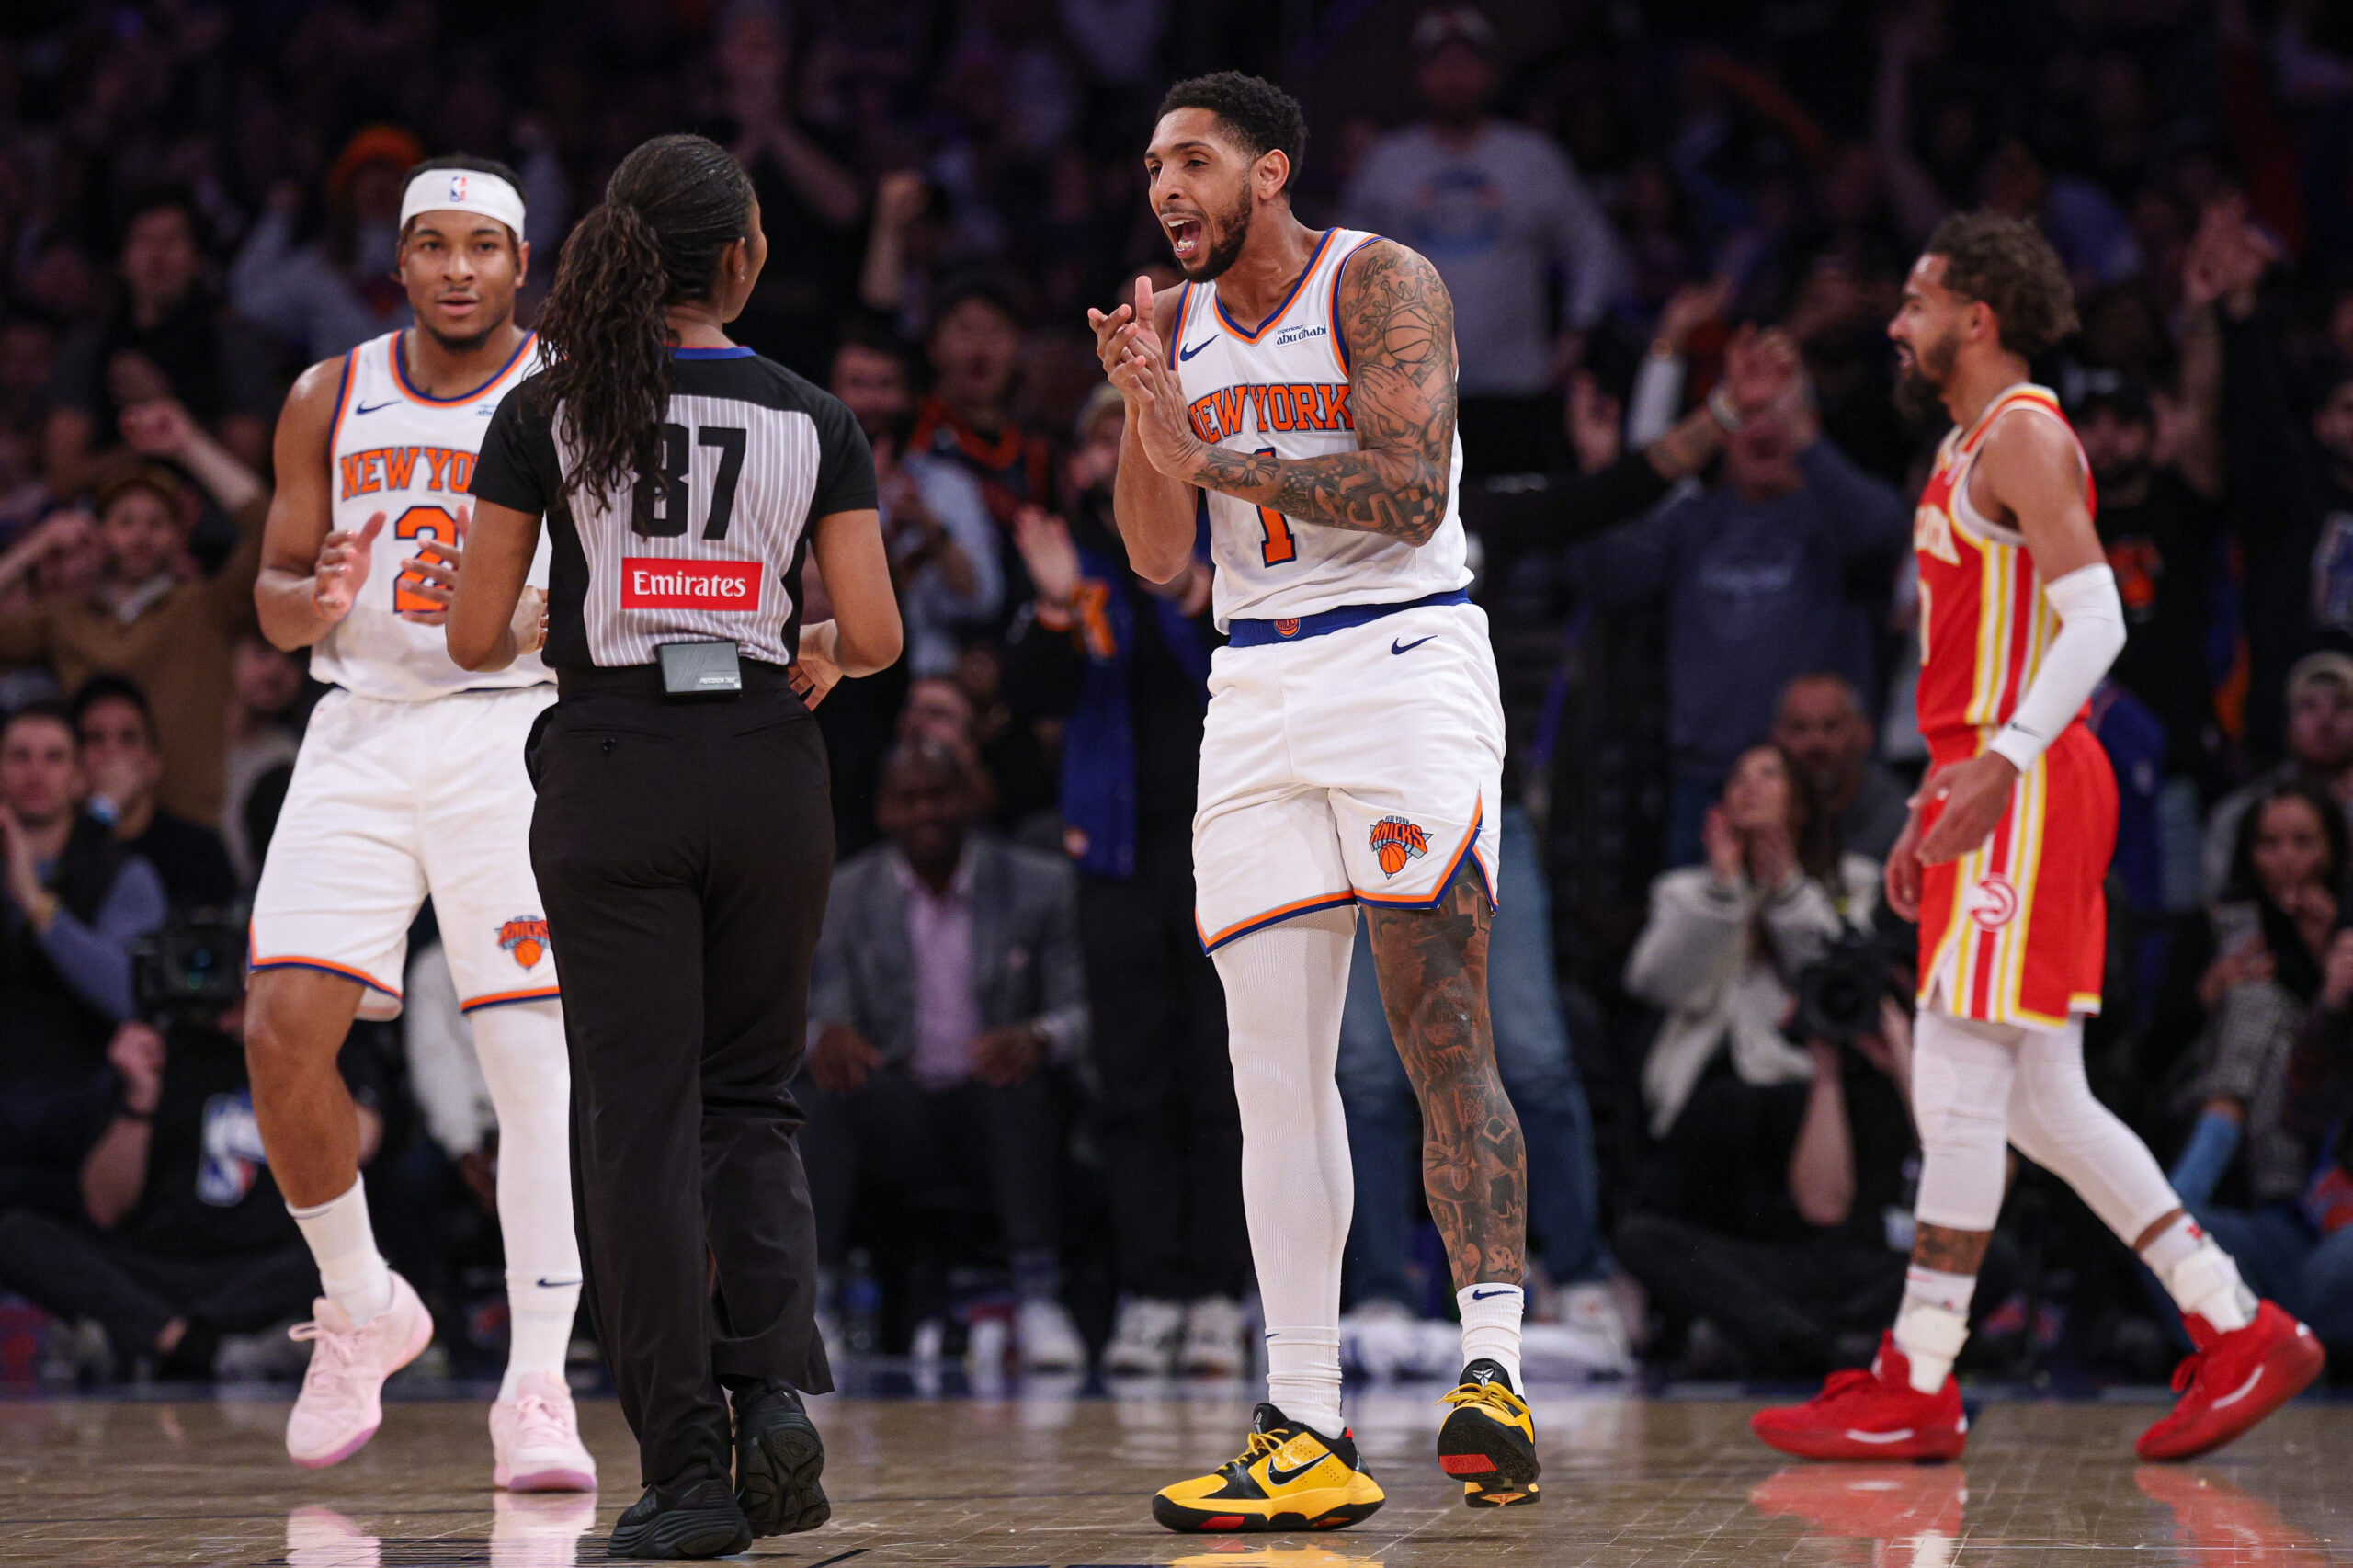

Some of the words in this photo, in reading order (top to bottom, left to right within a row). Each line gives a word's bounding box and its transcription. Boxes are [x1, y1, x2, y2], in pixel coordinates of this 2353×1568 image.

[1276, 334, 1297, 345] abu
[1298, 324, 1326, 340] dhabi
[1277, 324, 1303, 335] experience
[1249, 383, 1356, 432] YORK
[340, 448, 420, 501] NEW
[425, 448, 479, 494] YO
[631, 423, 747, 540] 87
[393, 506, 458, 614] 2
[632, 570, 746, 597] Emirates
[1369, 819, 1428, 855] KNICKS
[1395, 815, 1410, 824] YORK
